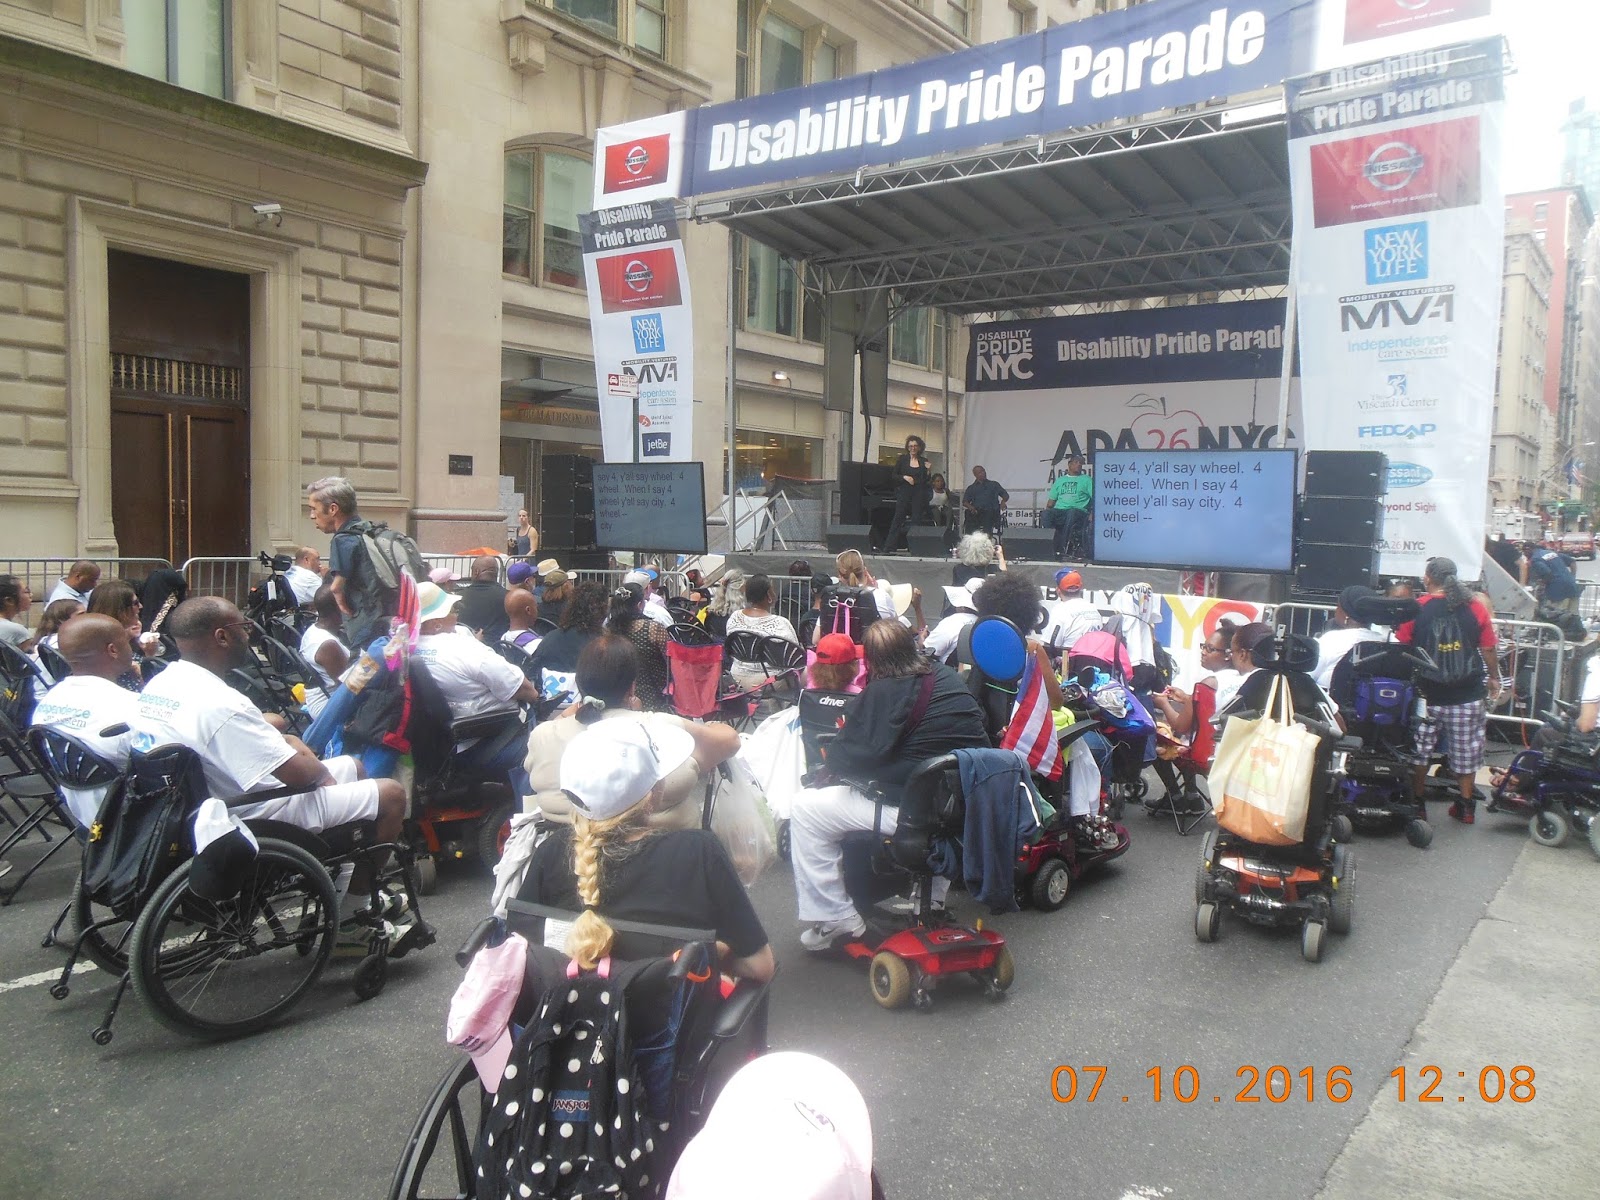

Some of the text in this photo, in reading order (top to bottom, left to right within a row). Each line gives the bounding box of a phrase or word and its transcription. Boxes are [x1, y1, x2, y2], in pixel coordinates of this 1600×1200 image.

[1329, 49, 1449, 94] Disability
[709, 8, 1265, 172] Disability Pride Parade
[1313, 79, 1473, 130] Pride Parade
[598, 203, 652, 226] Disability
[594, 223, 667, 249] Pride Parade
[1374, 228, 1419, 250] NEW
[1367, 242, 1424, 264] YORK
[1375, 258, 1418, 278] LIFE
[626, 271, 651, 280] NISSAN
[1346, 285, 1449, 303] MOBILITY VENTURES
[636, 318, 657, 330] NEW
[634, 327, 661, 340] YORK
[977, 329, 1031, 341] DISABILITY
[640, 338, 660, 349] LIFE
[976, 338, 1032, 356] PRIDE
[1057, 324, 1285, 362] Disability Pride Parad
[1348, 334, 1449, 352] Independence
[976, 353, 1034, 381] NYC
[1401, 397, 1439, 408] Center
[1358, 423, 1437, 438] FEDCAP
[1103, 463, 1125, 476] say
[1128, 462, 1140, 474] 4,
[1144, 461, 1169, 476] y'all
[1173, 464, 1195, 477] say
[1200, 461, 1244, 474] wheel.
[1253, 463, 1262, 474] 4
[636, 473, 648, 482] say
[625, 484, 646, 494] When
[652, 486, 665, 495] say
[1103, 478, 1143, 490] wheel.
[1152, 478, 1189, 490] When
[1202, 481, 1226, 492] say
[1229, 479, 1238, 490] 4
[636, 499, 649, 508] say
[1103, 494, 1243, 510] wheel y'all say city. 4
[1415, 502, 1436, 513] Sight
[1103, 510, 1139, 523] wheel
[600, 521, 613, 532] city
[1103, 527, 1124, 540] city
[1402, 540, 1425, 551] NYC
[819, 695, 845, 707] drive
